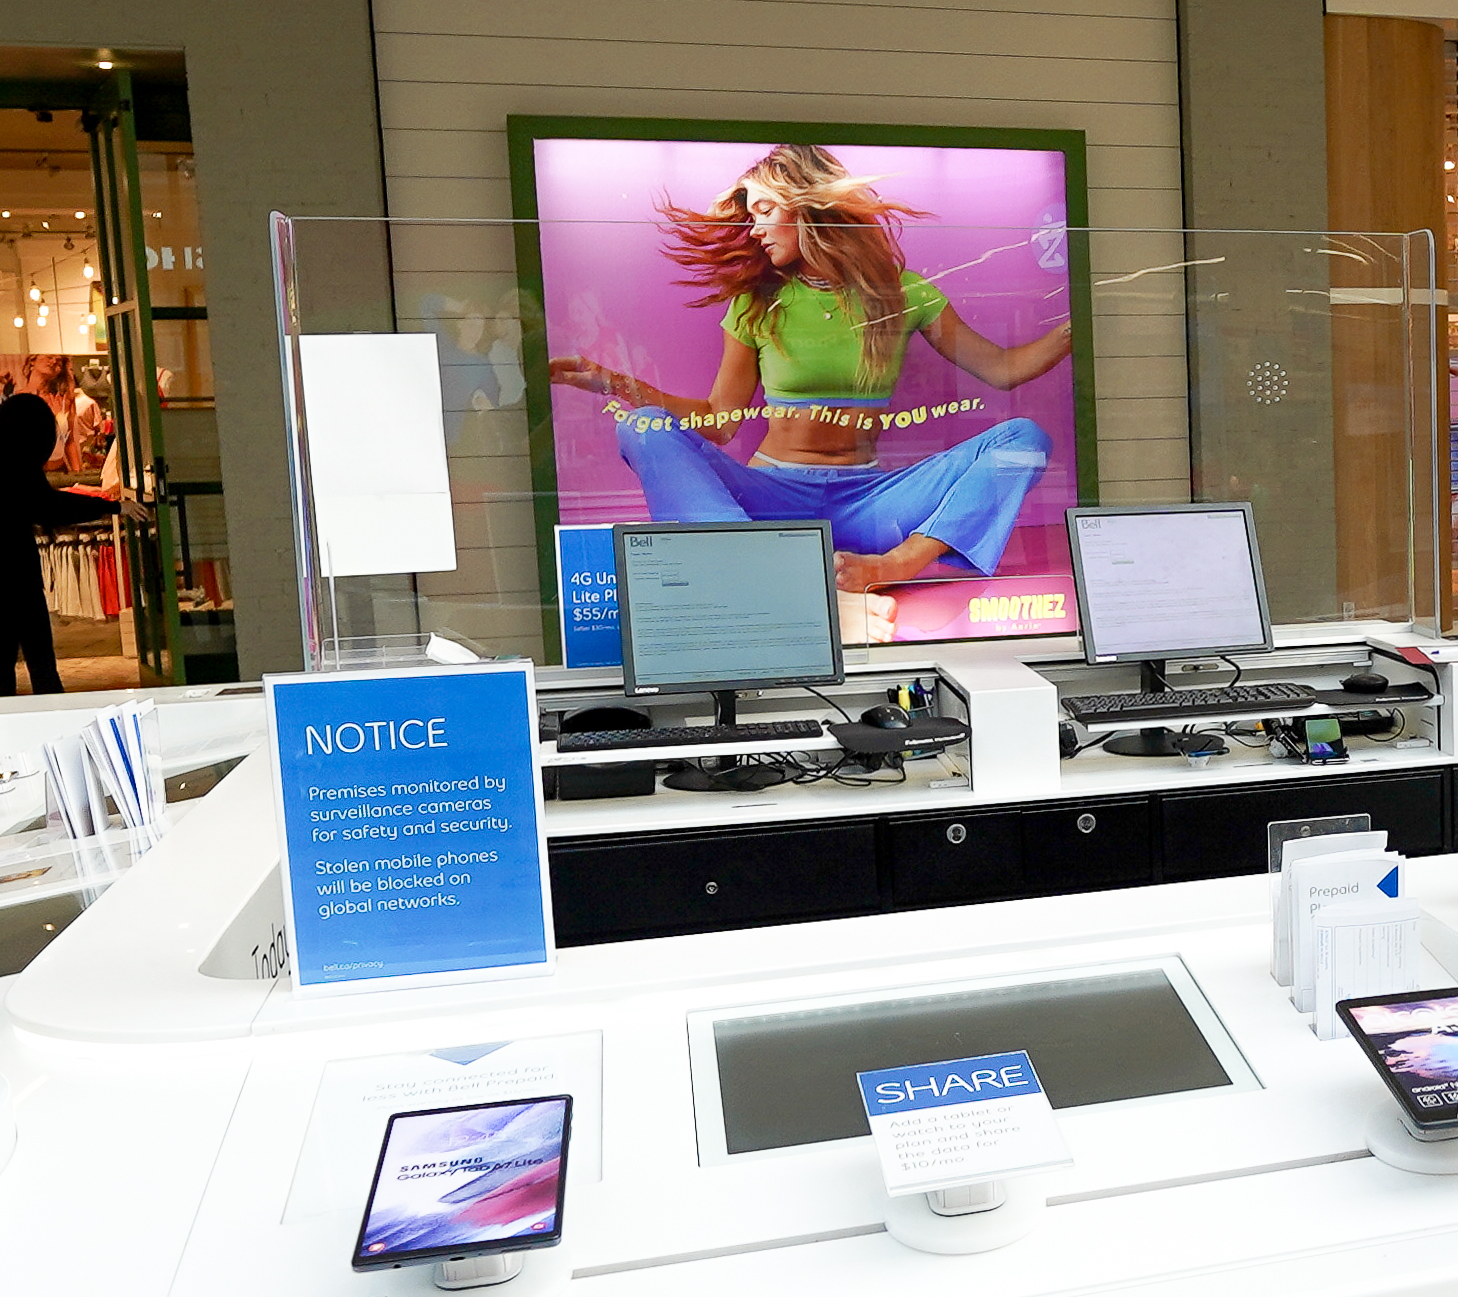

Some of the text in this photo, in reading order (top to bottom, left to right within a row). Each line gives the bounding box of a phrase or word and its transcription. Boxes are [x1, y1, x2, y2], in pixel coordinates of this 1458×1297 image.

[601, 395, 985, 434] Forget shapewear. This is YOU wear.
[1081, 519, 1102, 530] Bell
[630, 536, 653, 549] Bell
[571, 572, 592, 586] 4G
[572, 590, 600, 604] Lite
[969, 594, 1066, 623] SMOOTHEZ
[305, 718, 448, 755] NOTICE
[308, 775, 506, 802] Premises monitored by
[310, 797, 492, 822] surveillance cameras
[312, 816, 513, 843] for safety and security.
[315, 850, 499, 875] Stolen mobile phones
[316, 872, 472, 896] will be blocked on
[1309, 882, 1360, 899] Prepaid
[318, 892, 461, 920] global networks.
[375, 1065, 549, 1092] Stay connected for
[875, 1065, 1029, 1104] SHARE
[362, 1089, 397, 1102] less
[403, 1085, 442, 1097] with
[448, 1081, 480, 1092] Bell
[890, 1117, 921, 1129] Add
[944, 1108, 992, 1121] tablet
[997, 1105, 1014, 1113] or
[892, 1117, 1011, 1139] watch to your
[895, 1125, 1021, 1150] plan and share
[898, 1138, 1000, 1160] the data for
[396, 1166, 458, 1181] Galaxy
[399, 1157, 483, 1173] SAMSUNG
